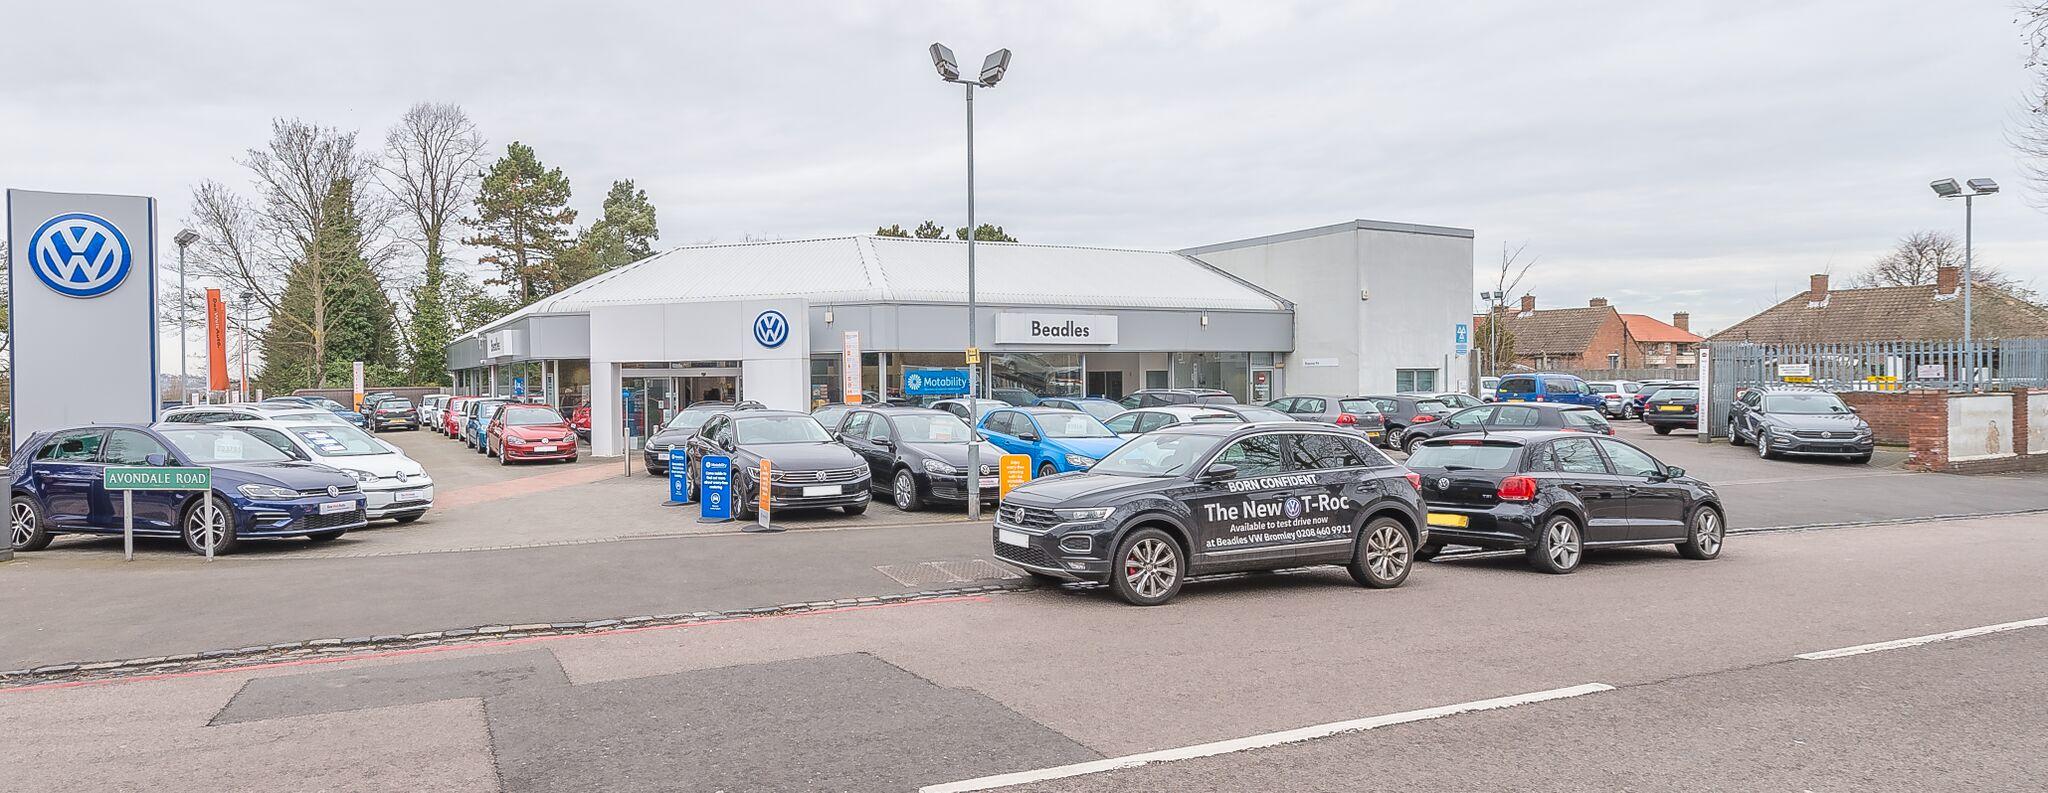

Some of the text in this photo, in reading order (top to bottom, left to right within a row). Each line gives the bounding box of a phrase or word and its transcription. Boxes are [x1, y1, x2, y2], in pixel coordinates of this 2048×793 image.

[1031, 320, 1090, 337] Beadles
[923, 376, 967, 389] Motability
[109, 473, 206, 484] AVONDALE ROAD
[1228, 474, 1318, 493] BORN CONFIDENT
[1204, 502, 1239, 522] The
[1242, 500, 1283, 519] New
[1301, 494, 1351, 513] T-Roc
[1229, 515, 1329, 533] Available to test drive now
[1206, 524, 1352, 548] at Beadles VW Bromley 0208 460 9911
